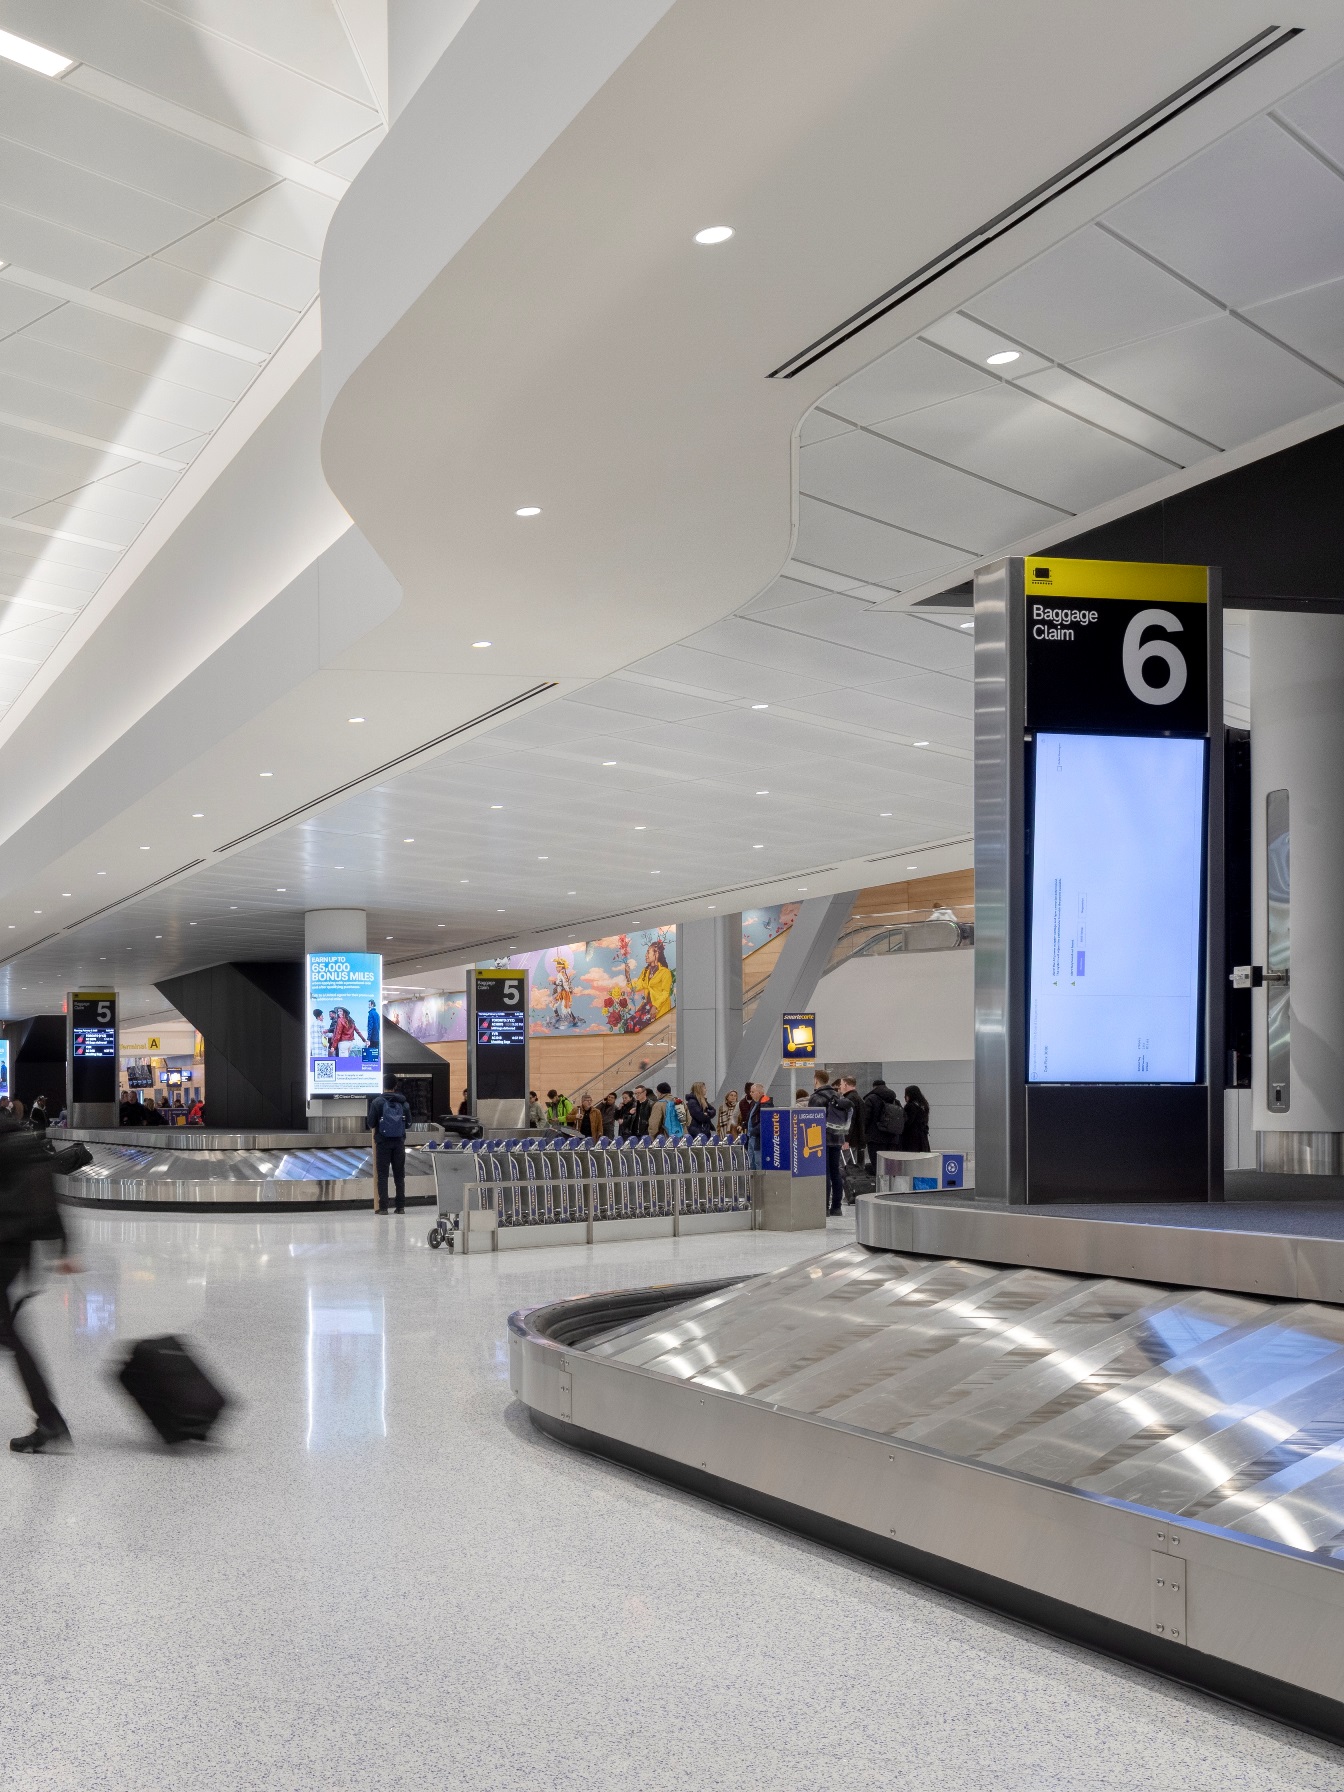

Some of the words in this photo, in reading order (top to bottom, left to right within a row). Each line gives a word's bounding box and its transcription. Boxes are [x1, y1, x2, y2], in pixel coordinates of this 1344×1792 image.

[1033, 604, 1099, 625] Baggage
[1033, 625, 1075, 641] Claim
[1122, 608, 1188, 706] 6
[312, 963, 350, 972] 65,000
[312, 972, 348, 981] BONUS
[350, 972, 374, 981] MILES
[503, 980, 520, 1005] 5
[96, 1001, 112, 1022] 5
[149, 1038, 159, 1049] A
[772, 1113, 780, 1168] smartecarte
